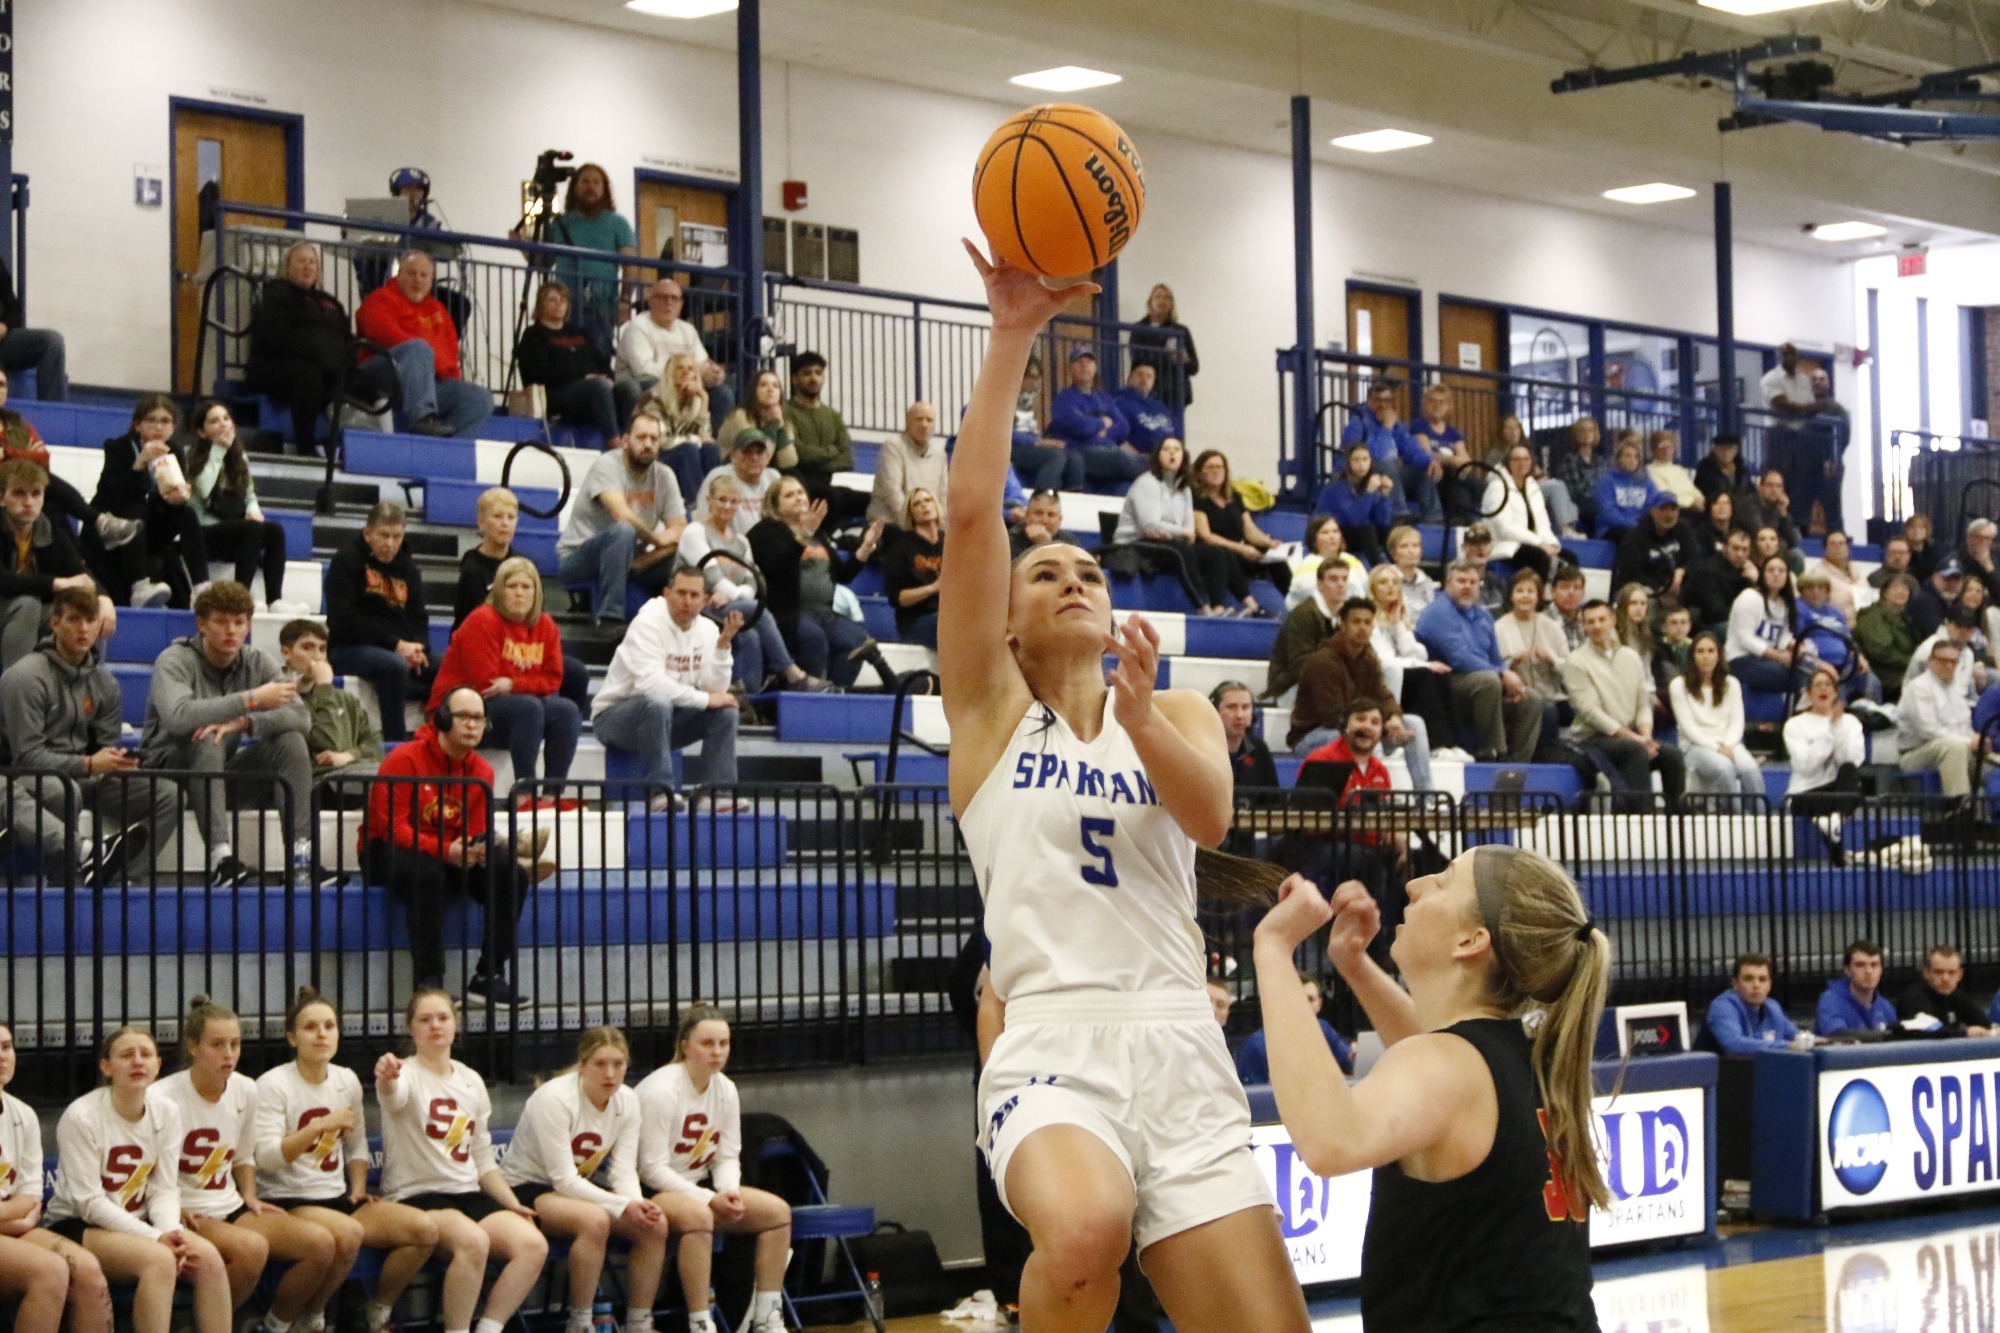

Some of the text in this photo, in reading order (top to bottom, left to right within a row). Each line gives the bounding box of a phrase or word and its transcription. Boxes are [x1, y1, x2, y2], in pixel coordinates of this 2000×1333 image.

[1084, 152, 1130, 258] Wilson
[1081, 816, 1118, 887] 5
[1912, 1072, 2000, 1190] SPA
